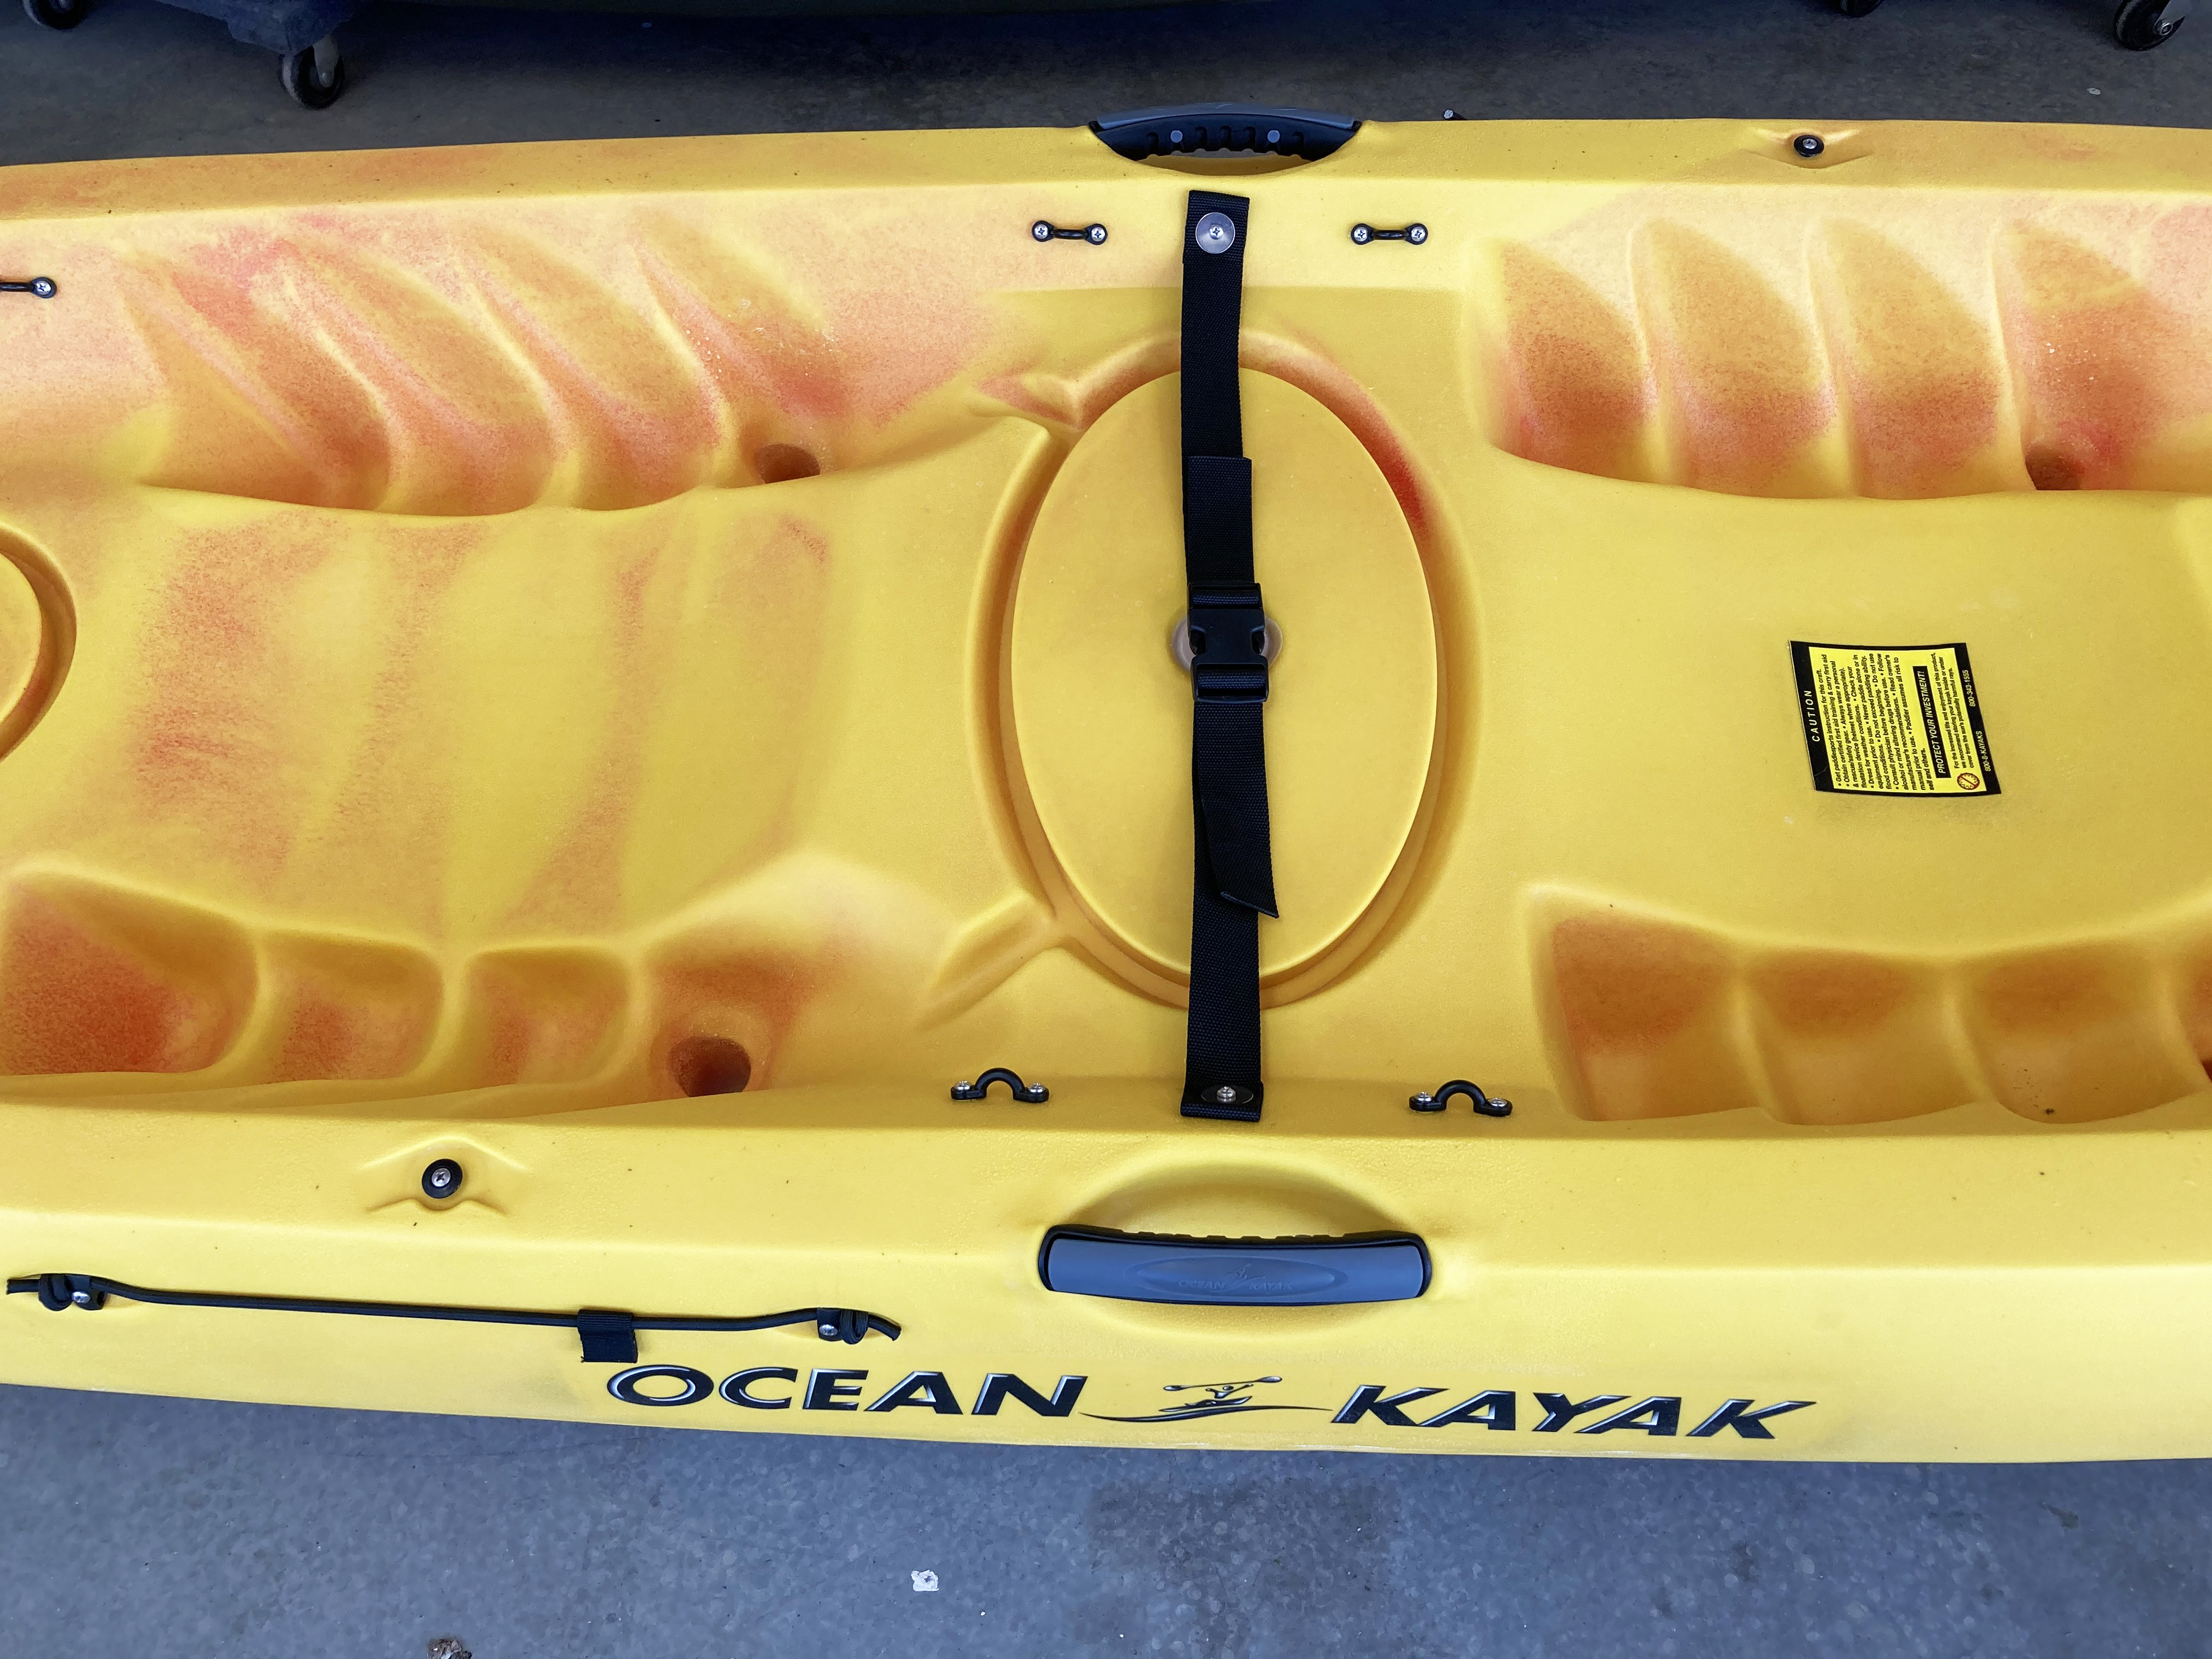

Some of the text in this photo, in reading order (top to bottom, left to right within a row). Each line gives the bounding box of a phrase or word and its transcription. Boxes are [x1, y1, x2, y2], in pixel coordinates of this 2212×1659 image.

[1830, 661, 1841, 685] personal
[1872, 675, 1878, 683] Do
[1838, 667, 1851, 702] appropriate).
[1848, 679, 1857, 697] Check
[1858, 684, 1867, 703] paddle
[1864, 674, 1875, 698] paddling
[1898, 683, 1908, 708] assumes
[1949, 679, 1958, 698] harmful
[1829, 696, 1837, 718] training
[1867, 698, 1877, 719] exceed
[1875, 688, 1885, 717] beginning.
[1883, 689, 1892, 708] before
[1937, 687, 1946, 712] enjoyment
[1954, 697, 1964, 722] potentially
[1804, 690, 1820, 742] CAUTION
[1823, 704, 1833, 734] instruction
[1838, 705, 1847, 725] Always
[1854, 704, 1864, 735] conditions.
[1887, 708, 1895, 725] drugs
[1903, 708, 1912, 730] Paddler
[1948, 705, 1956, 716] your
[1848, 721, 1859, 742] (helmet
[1881, 718, 1889, 736] before
[1884, 654, 1917, 791] manufacturer's recommendations. Read owner's
[1917, 671, 1946, 774] PROTECT YOUR INVESTMENT!
[1843, 730, 1852, 744] gear.
[1875, 730, 1881, 738] Do
[1891, 725, 1899, 747] altering
[1945, 729, 1956, 752] increased
[1828, 735, 1841, 771] paddlesports
[1836, 740, 1846, 763] certified
[1853, 742, 1862, 761] device
[1860, 735, 1869, 758] weather
[1870, 745, 1878, 759] prior
[1884, 736, 1896, 763] physician
[1894, 747, 1903, 761] mind
[1954, 733, 1965, 761] recommend
[1846, 744, 1858, 782] rescue/safety
[1878, 743, 1889, 774] conditions.
[1913, 755, 1922, 769] prior
[1920, 748, 1934, 791] self and others.
[1841, 764, 1850, 783] Obtain
[1858, 762, 1867, 788] floatation
[1866, 768, 1875, 785] Dress
[1872, 759, 1884, 789] equipment
[1883, 775, 1892, 789] flood
[1889, 764, 1899, 786] Consult
[1898, 770, 1909, 791] alcohol
[1915, 770, 1926, 791] manual
[607, 1364, 1817, 1440] OCEAN KAYAK
